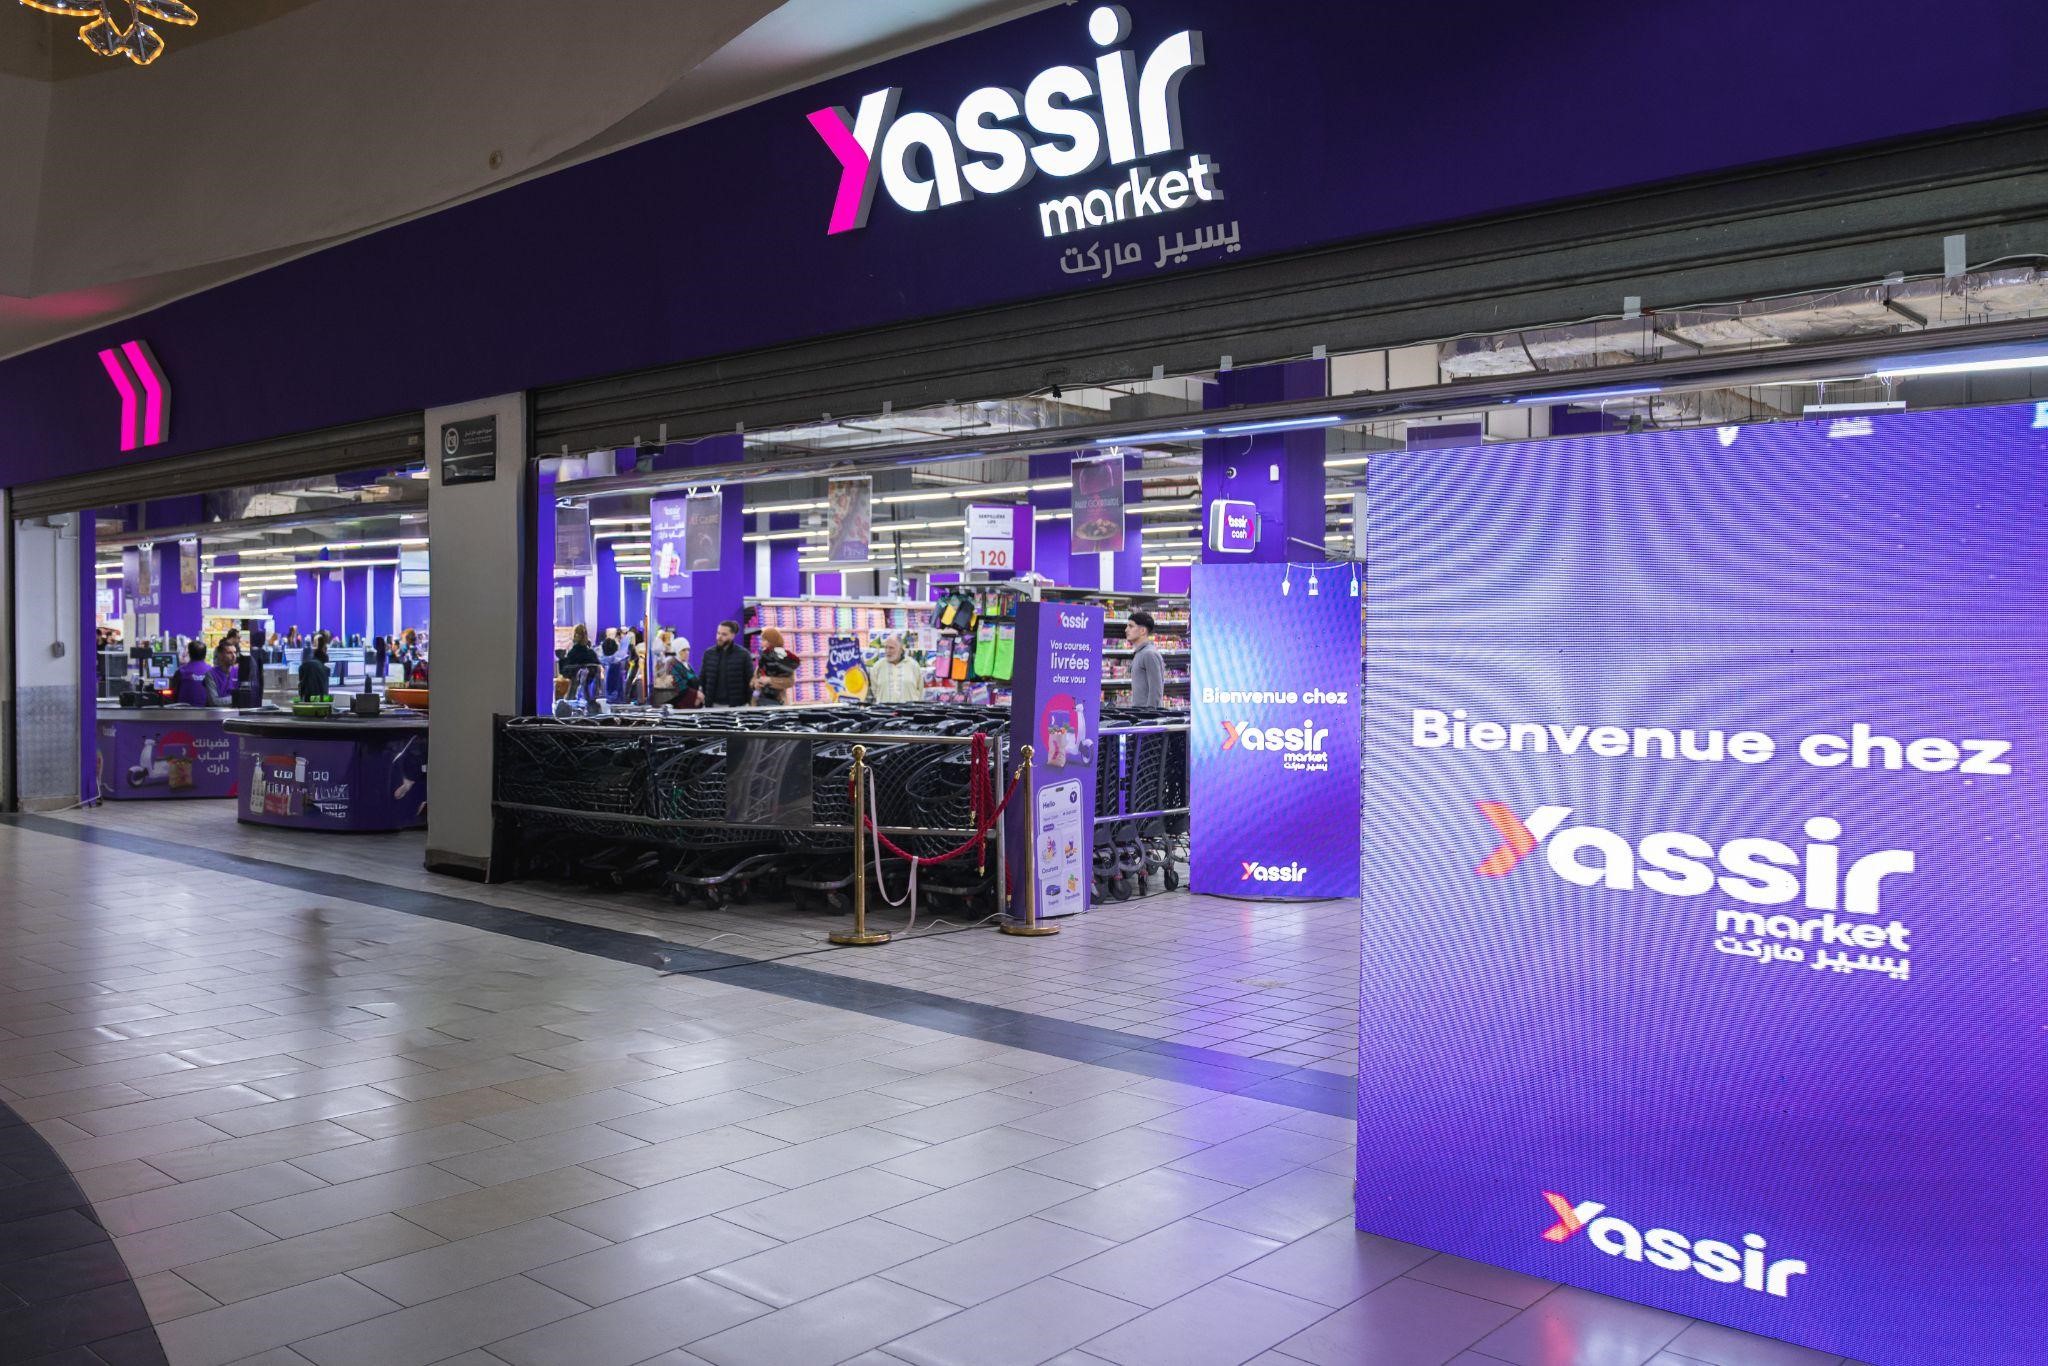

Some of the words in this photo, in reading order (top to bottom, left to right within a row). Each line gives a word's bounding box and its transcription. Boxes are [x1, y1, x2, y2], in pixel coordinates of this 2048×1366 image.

[806, 6, 1203, 236] Yassir
[1039, 154, 1218, 237] market
[1154, 221, 1241, 269] يسير
[1060, 241, 1142, 279] ماركت
[1232, 529, 1247, 539] cash
[980, 550, 1006, 567] 120
[1050, 640, 1063, 650] Vos
[1064, 643, 1092, 653] courses,
[1051, 652, 1090, 670] livrées
[1053, 673, 1069, 683] chez
[1070, 676, 1086, 684] vous
[1202, 687, 1298, 704] Bienvenue
[1302, 687, 1348, 704] chez
[1221, 719, 1329, 752] Yassir
[1412, 708, 1775, 764] Bienvenue
[1799, 722, 2012, 775] chez
[1283, 750, 1328, 762] market
[1042, 800, 1056, 809] Hello
[1241, 861, 1307, 882] Yassir
[1474, 799, 1915, 915] Yassir
[1715, 909, 1911, 952] market
[1713, 936, 1805, 964] ماركت
[1811, 949, 1911, 980] يسير
[1541, 1190, 1808, 1298] Yassir
